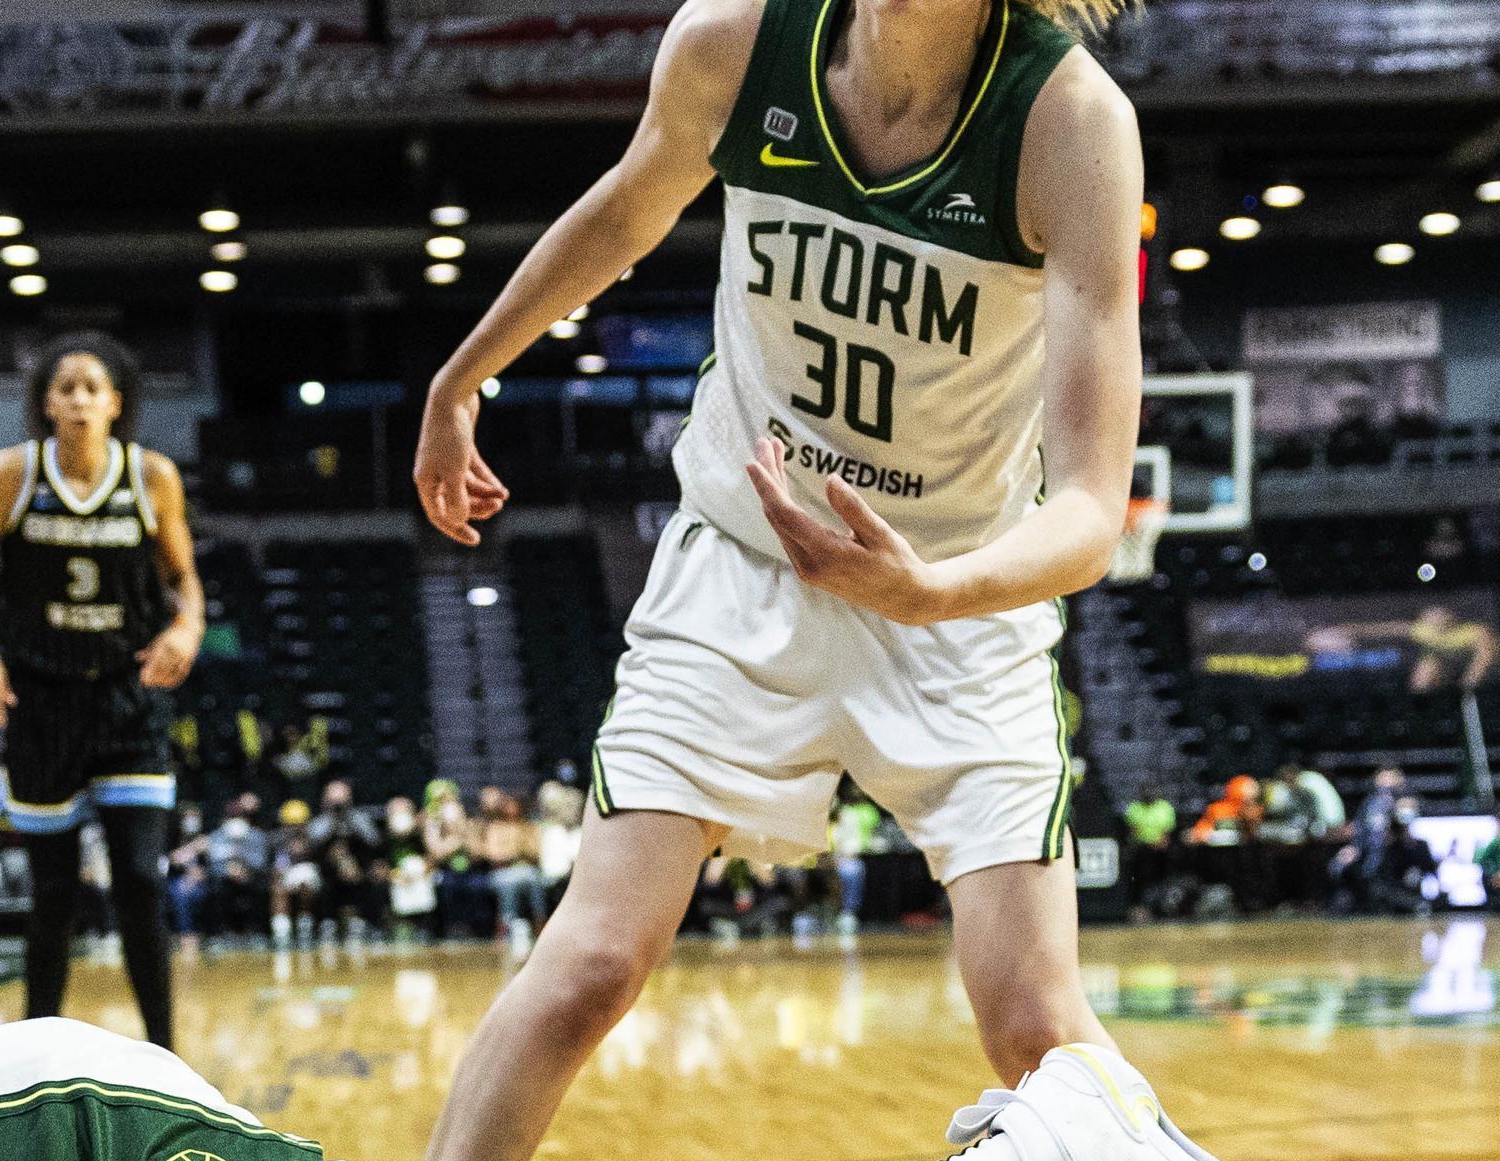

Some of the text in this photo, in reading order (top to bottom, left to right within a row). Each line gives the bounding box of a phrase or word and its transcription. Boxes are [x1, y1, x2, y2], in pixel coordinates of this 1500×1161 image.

[927, 207, 986, 224] SYMETRA
[747, 220, 979, 356] STORM
[790, 320, 896, 443] 30
[799, 444, 923, 498] SWEDISH
